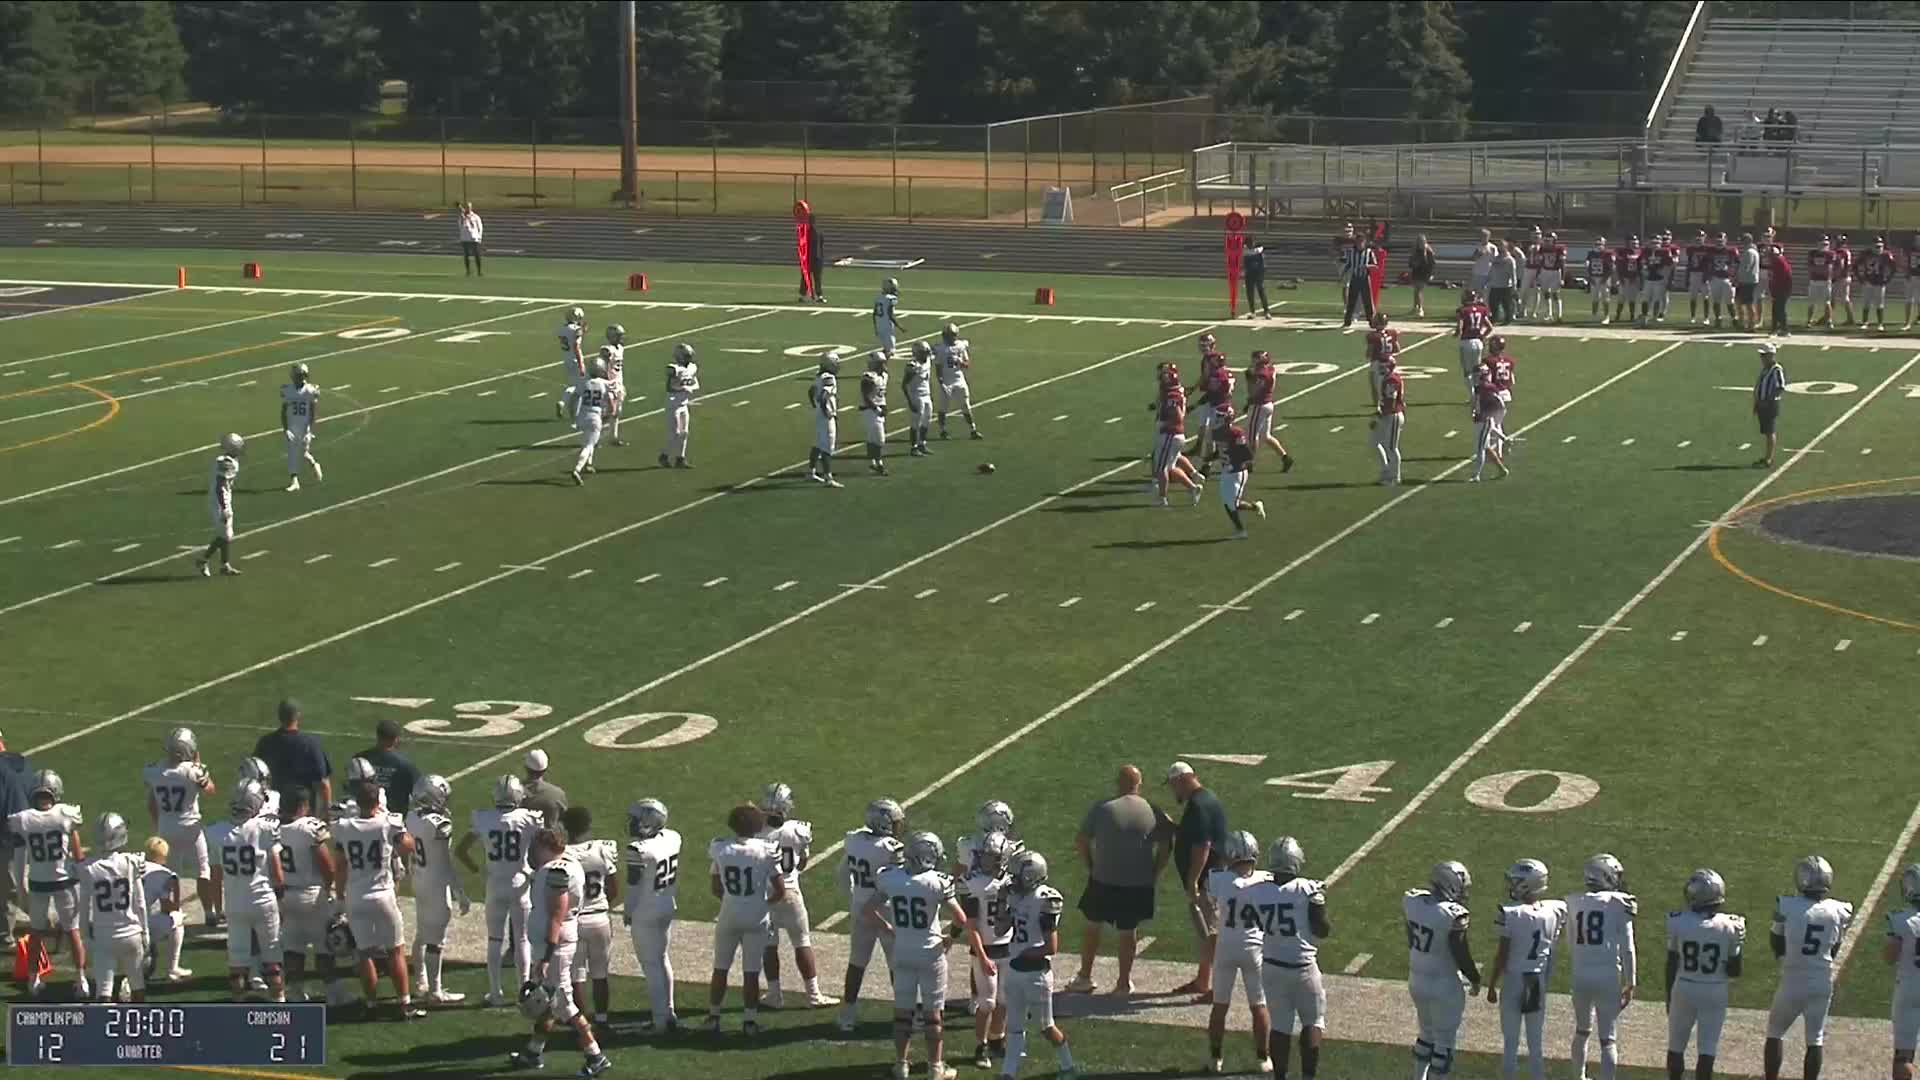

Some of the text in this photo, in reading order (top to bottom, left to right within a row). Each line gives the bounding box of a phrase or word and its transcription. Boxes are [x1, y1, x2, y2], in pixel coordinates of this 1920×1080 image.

[1469, 312, 1482, 329] 17
[156, 786, 186, 813] 37
[30, 831, 63, 862] 82
[222, 845, 256, 876] 59
[349, 839, 382, 870] 84
[488, 830, 521, 862] 38
[653, 855, 678, 890] 25
[725, 866, 755, 897] 81
[94, 879, 130, 913] 23
[893, 896, 929, 930] 66
[1259, 903, 1297, 937] 75
[1575, 911, 1604, 945] 18
[1527, 929, 1541, 960] 1
[1801, 924, 1825, 956] 5
[1682, 941, 1721, 975] 83
